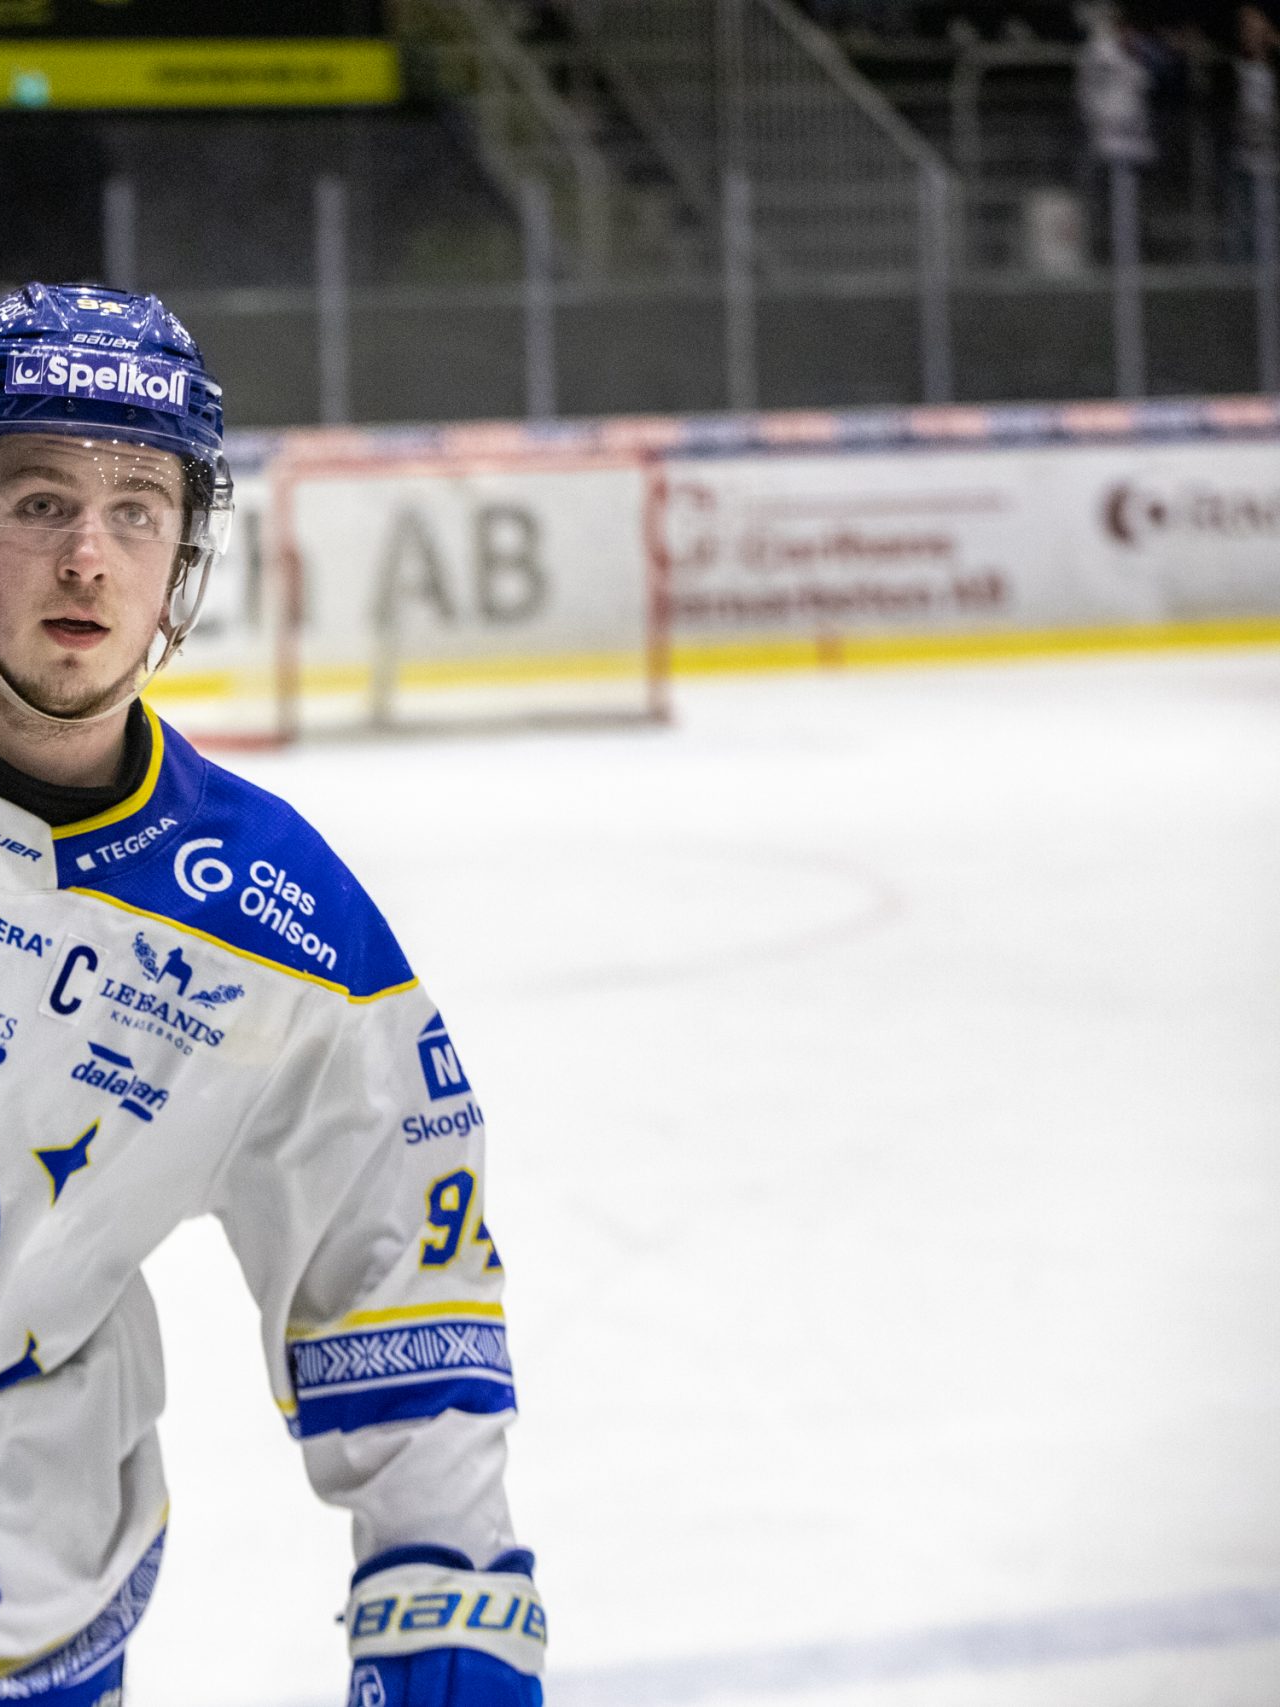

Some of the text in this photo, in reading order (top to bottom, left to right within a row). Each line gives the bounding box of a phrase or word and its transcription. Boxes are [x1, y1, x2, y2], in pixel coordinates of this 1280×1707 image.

[47, 354, 186, 406] Spelkoll
[96, 815, 178, 864] TEGERA
[248, 859, 317, 918] Clas
[239, 886, 339, 971] Ohlson
[49, 944, 99, 1016] C
[401, 1101, 485, 1145] Skogl
